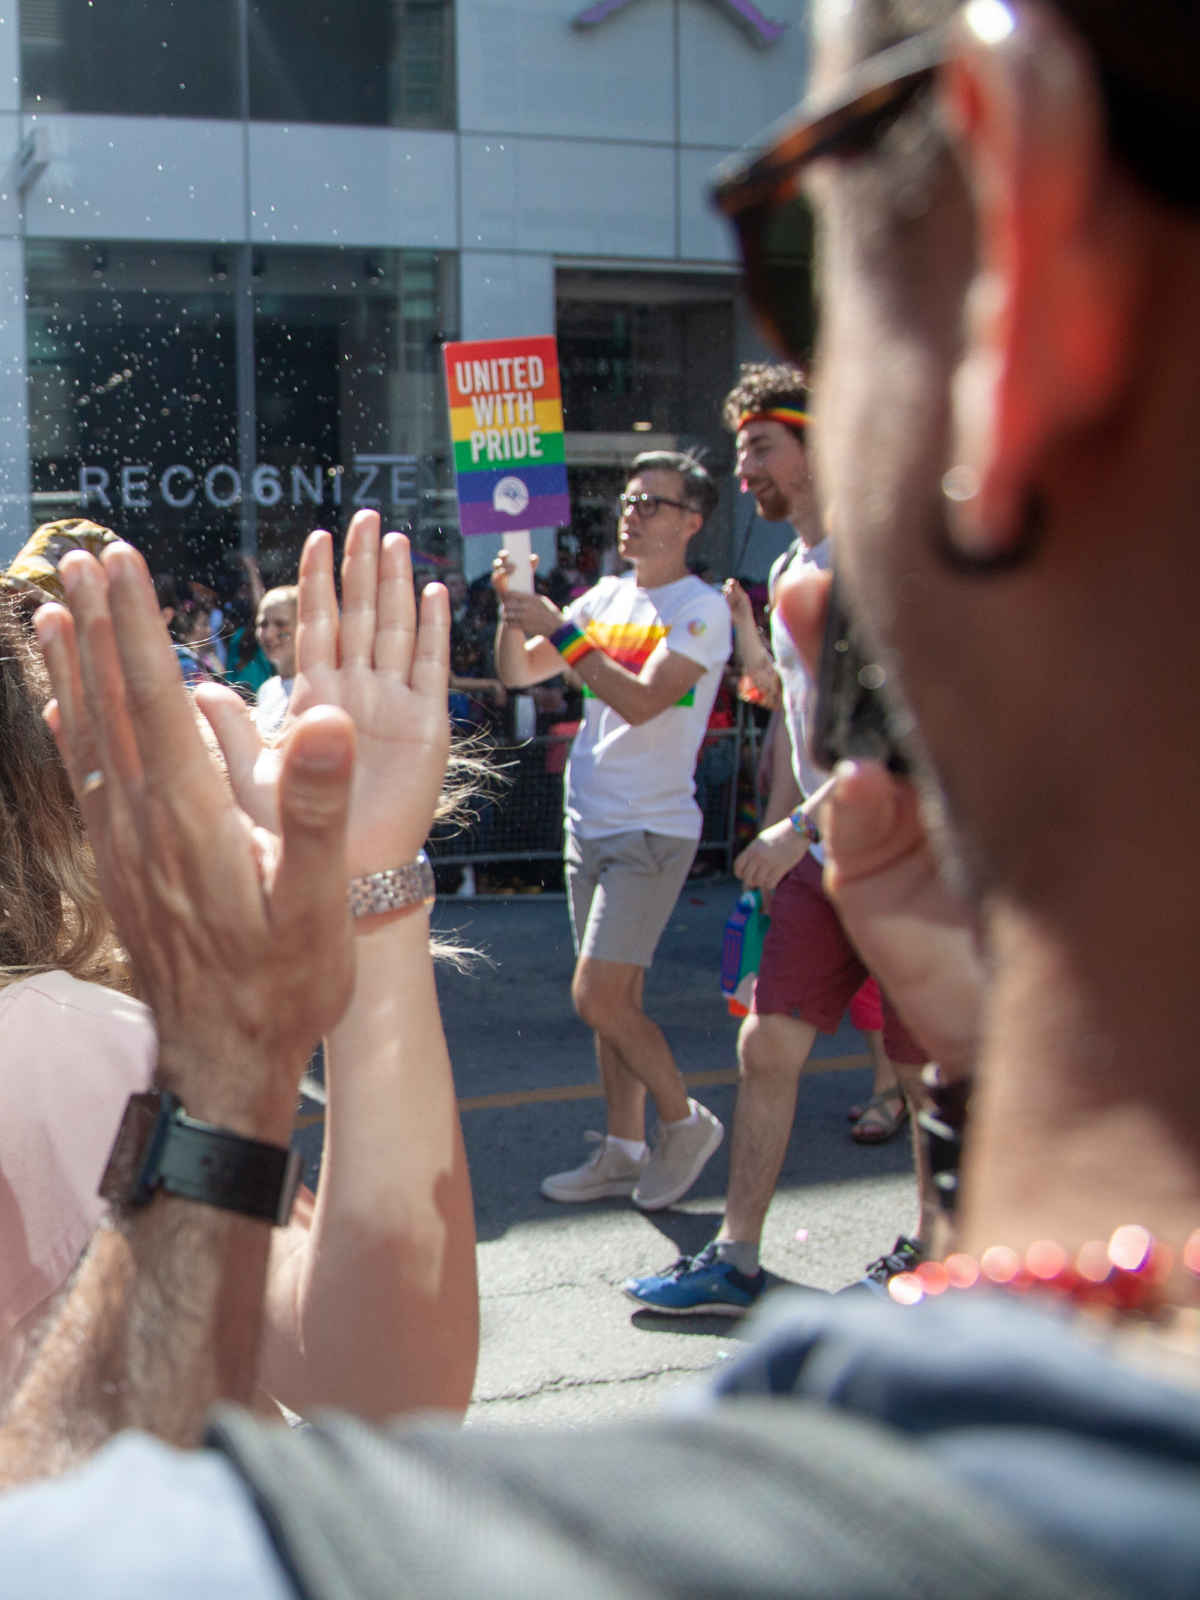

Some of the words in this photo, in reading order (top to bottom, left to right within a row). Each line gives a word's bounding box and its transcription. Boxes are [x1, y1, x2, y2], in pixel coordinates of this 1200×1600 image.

[455, 355, 544, 394] UNITED
[471, 391, 535, 427] WITH
[470, 425, 543, 463] PRIDE
